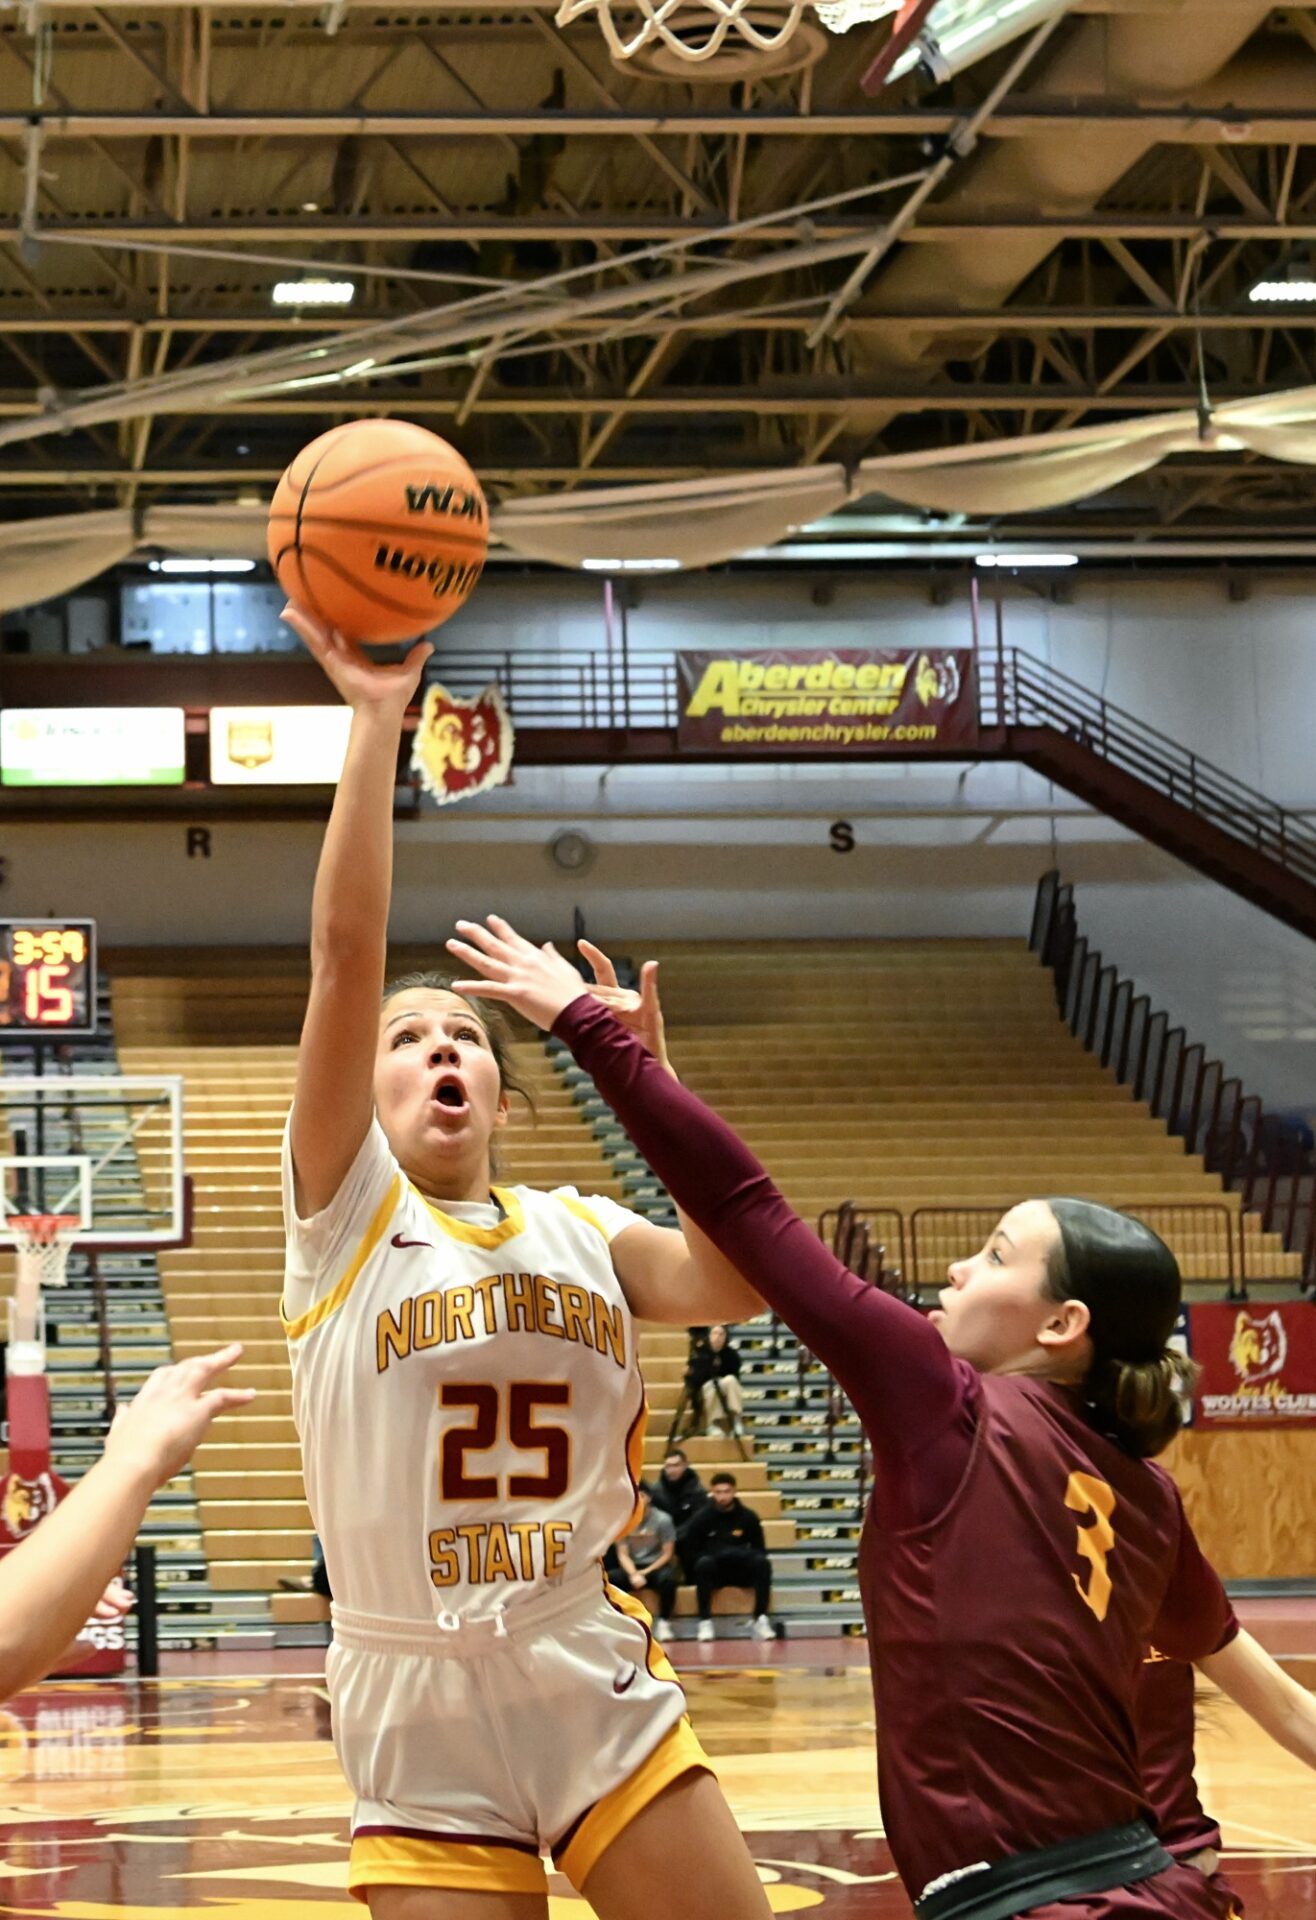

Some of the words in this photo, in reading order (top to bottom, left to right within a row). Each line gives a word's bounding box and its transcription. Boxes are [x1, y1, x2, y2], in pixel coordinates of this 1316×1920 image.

[685, 659, 907, 717] Aberdeen
[740, 697, 826, 718] Chrysler
[828, 698, 900, 716] Center
[721, 723, 937, 744] aberdeenchrysler.com
[187, 827, 211, 859] R
[830, 821, 855, 854] S
[13, 930, 85, 965] 3:59
[25, 964, 73, 1022] 15
[376, 1273, 626, 1375] NORTHERN
[437, 1380, 573, 1504] 25
[428, 1522, 573, 1588] STATE
[1064, 1470, 1117, 1622] 3
